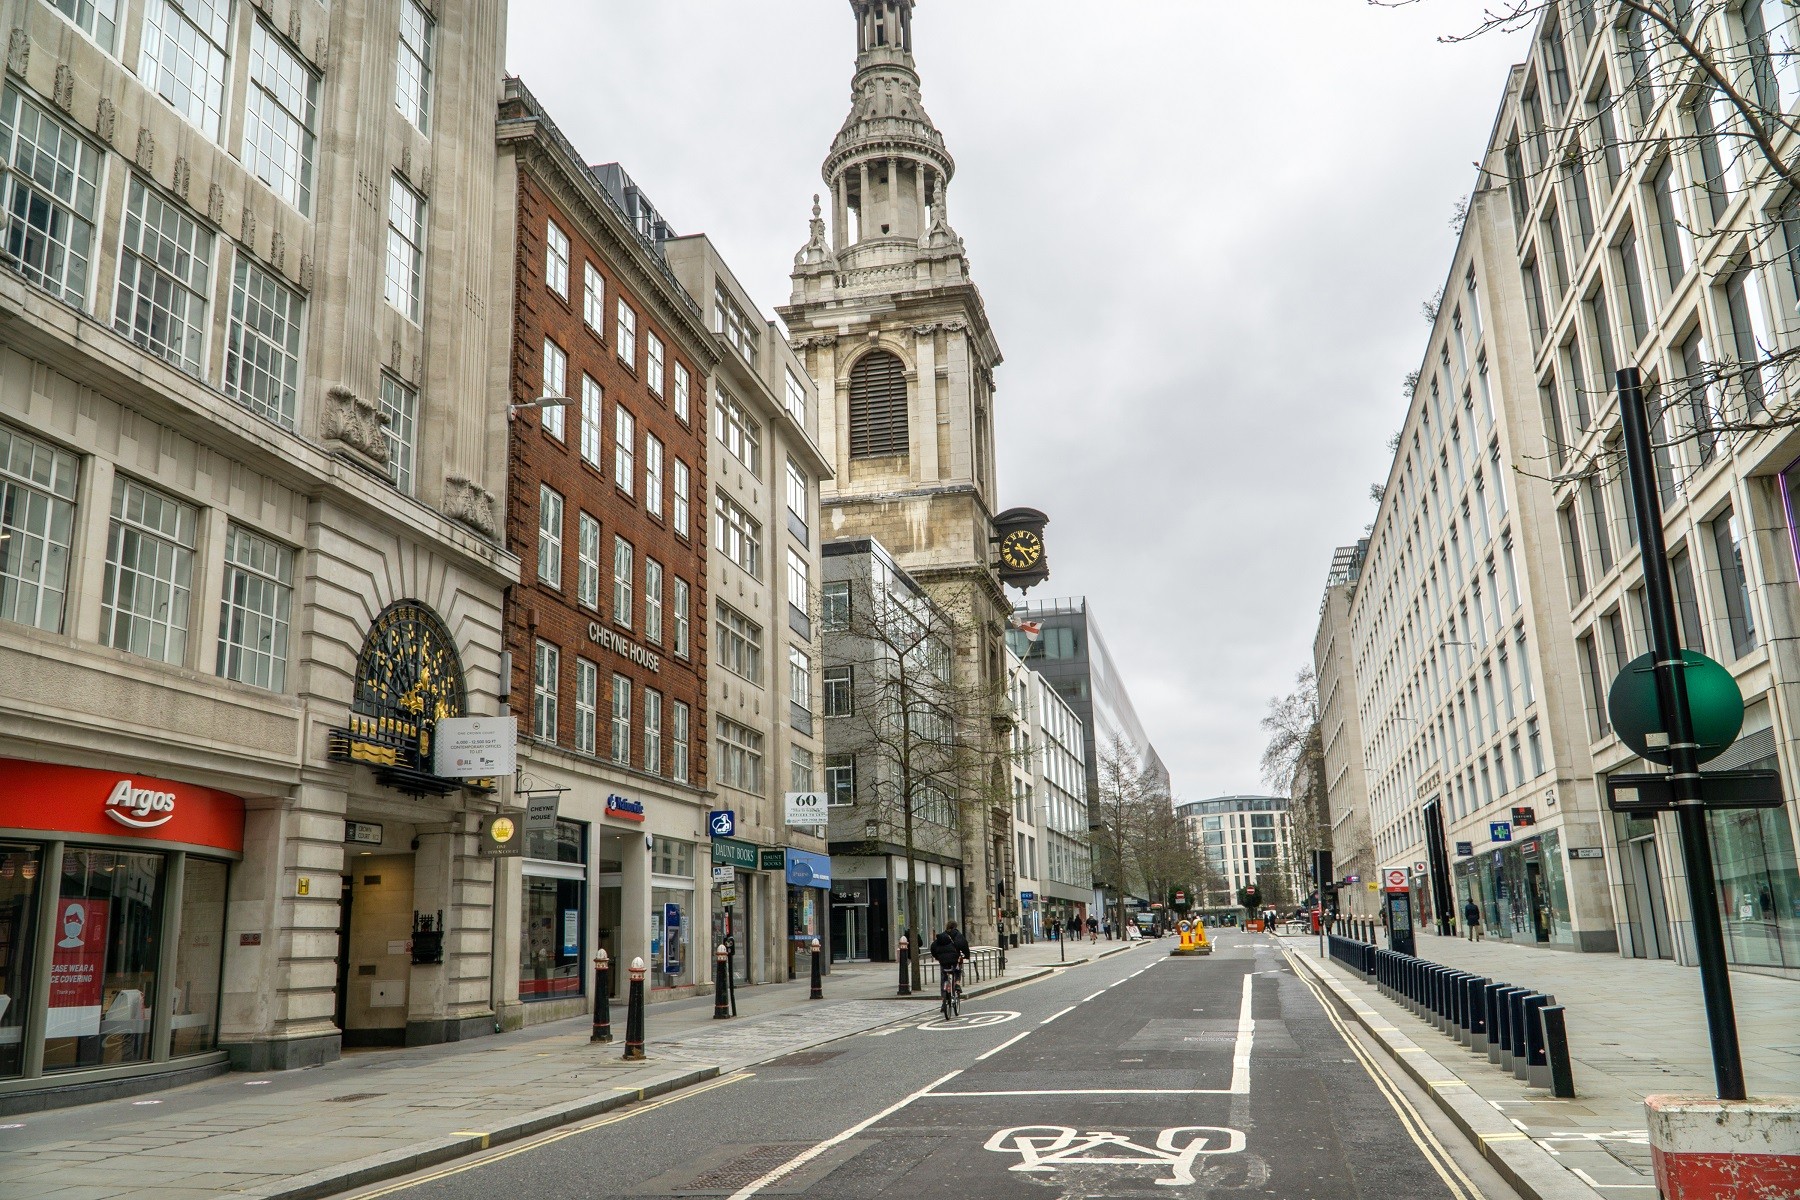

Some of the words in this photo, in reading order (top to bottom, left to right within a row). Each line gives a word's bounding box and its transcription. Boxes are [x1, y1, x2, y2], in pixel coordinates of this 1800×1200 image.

[588, 621, 628, 657] CHEYNE
[629, 642, 659, 673] HOUSE
[106, 780, 176, 816] Argos
[615, 796, 644, 814] Nationwide
[796, 794, 817, 806] 60
[715, 843, 735, 858] DAUNT
[736, 847, 754, 862] BOOKS
[51, 964, 69, 973] EASE
[69, 964, 88, 973] WEAR
[88, 964, 94, 972] A
[51, 975, 59, 984] CE
[60, 975, 92, 984] COVERING
